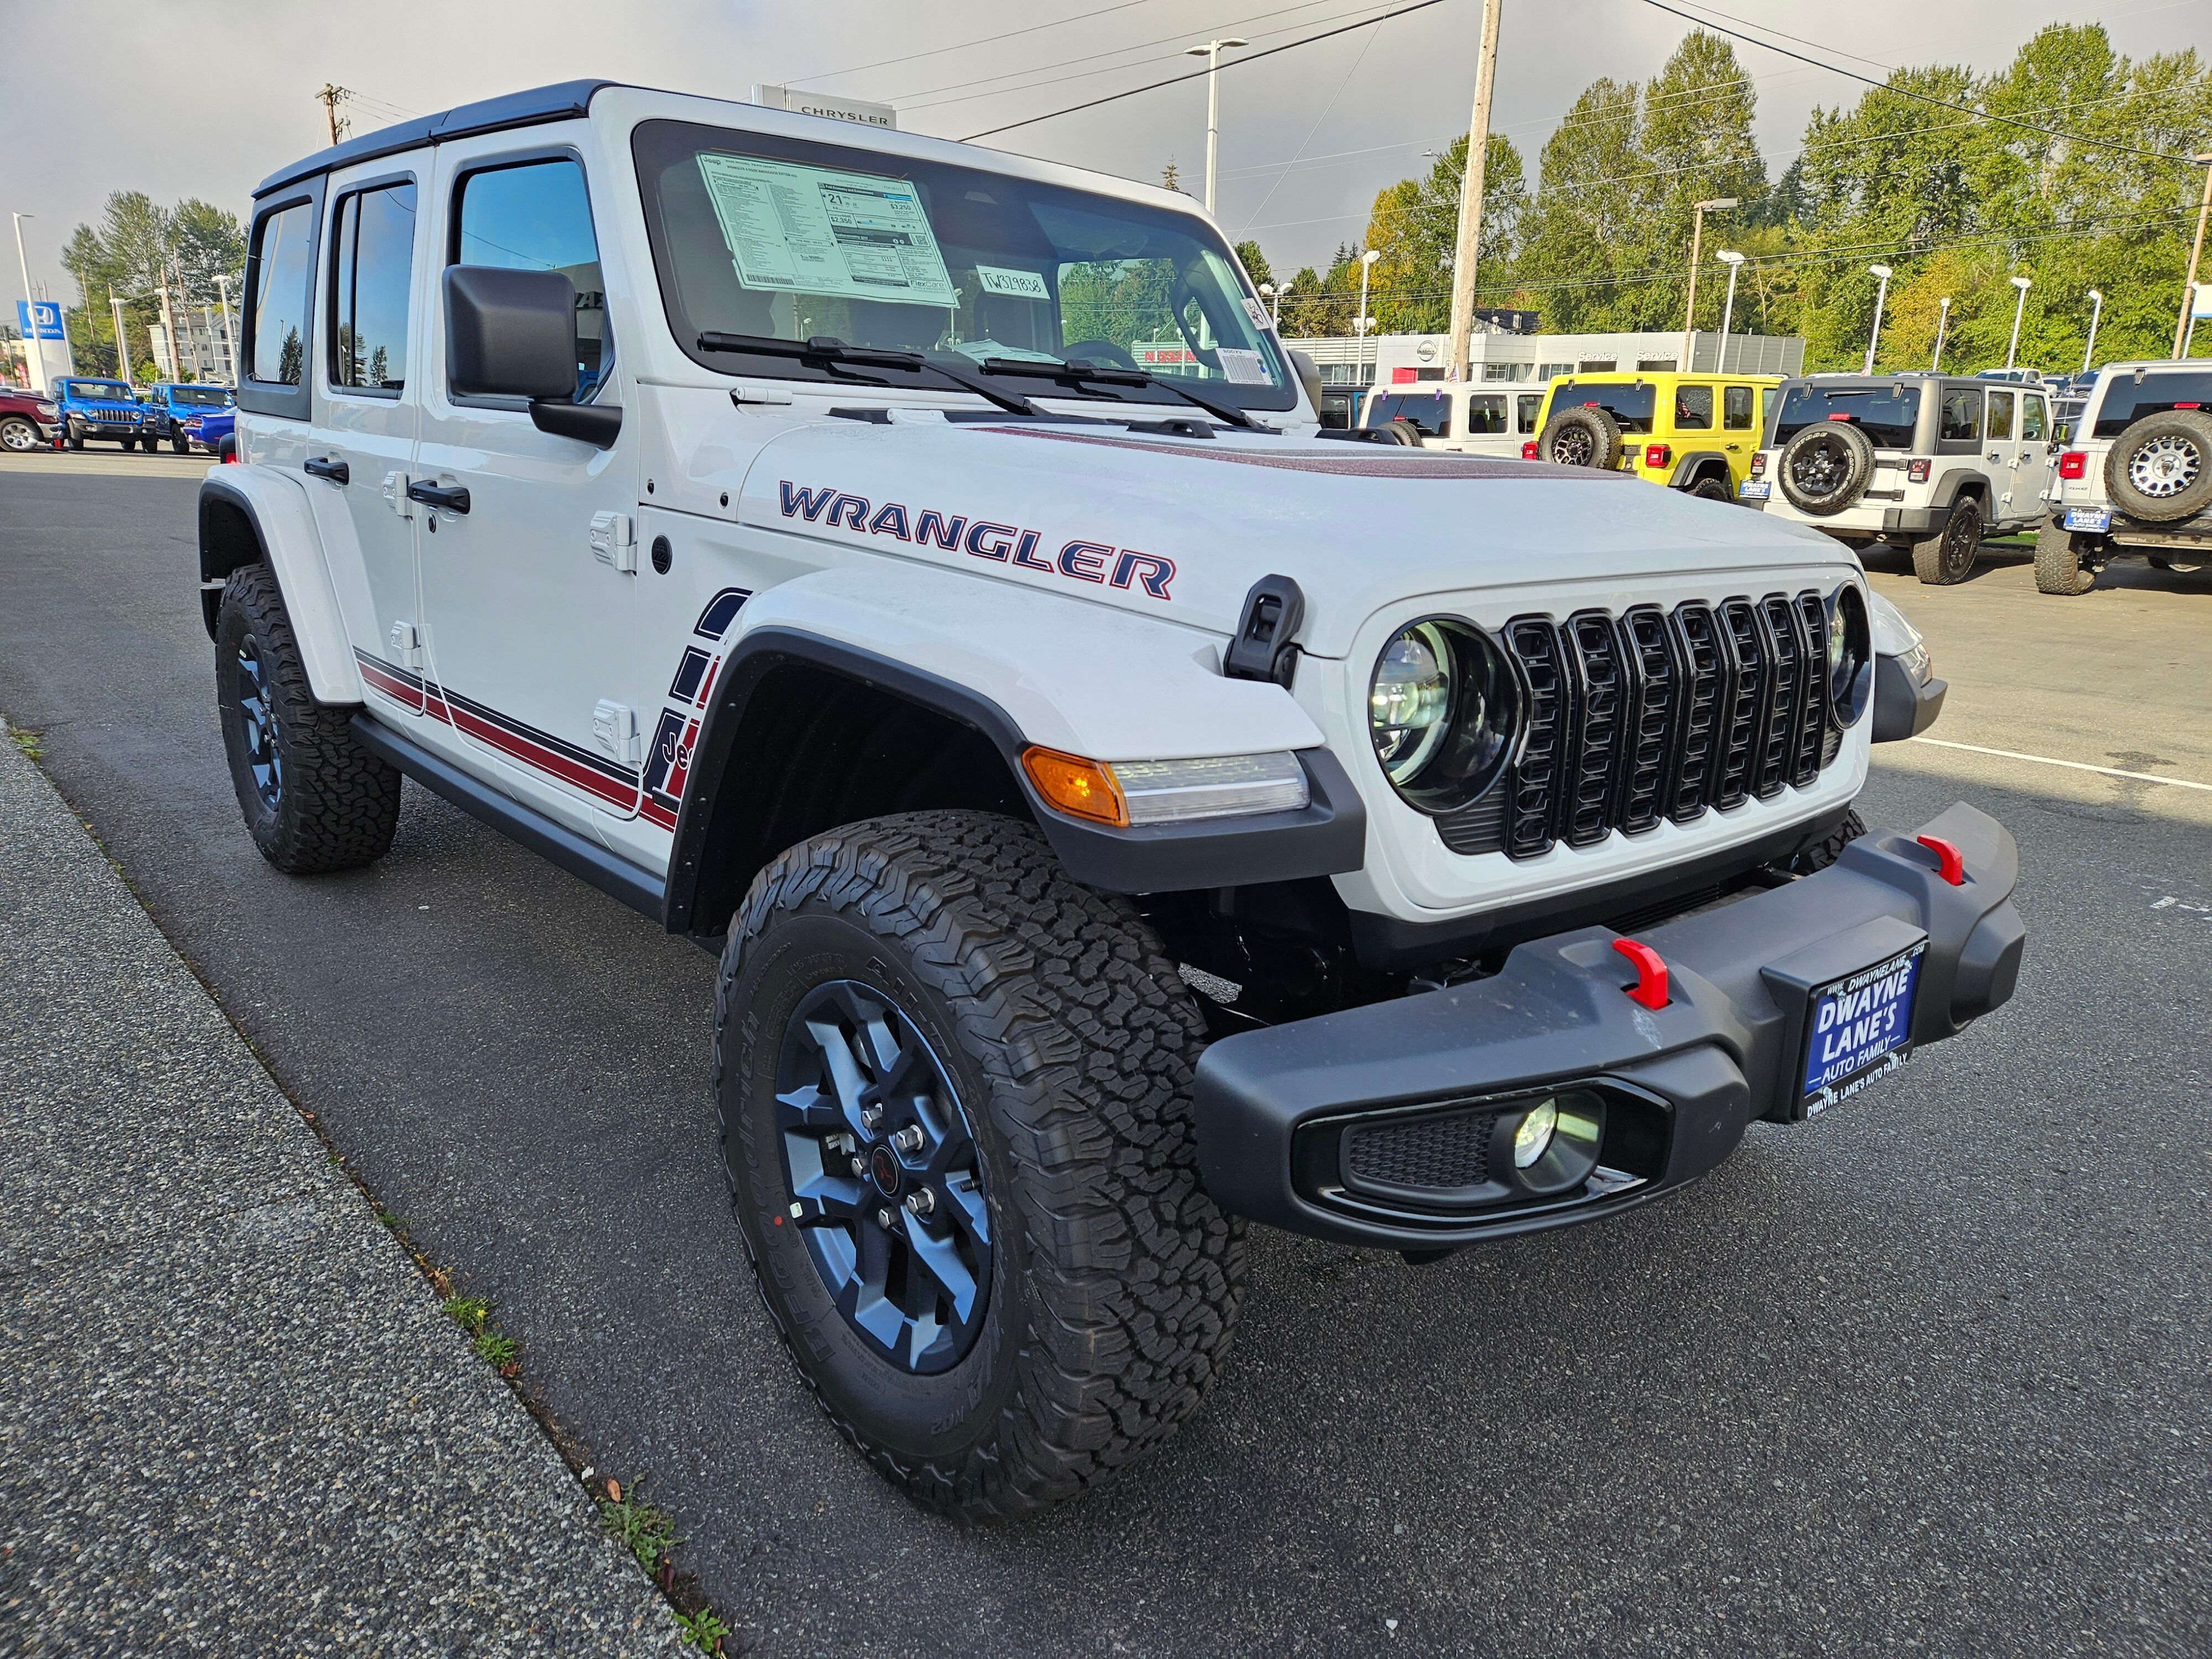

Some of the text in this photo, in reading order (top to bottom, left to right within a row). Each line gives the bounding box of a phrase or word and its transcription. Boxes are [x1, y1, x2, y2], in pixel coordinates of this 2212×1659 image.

[802, 107, 888, 126] CHRYSLER
[828, 194, 842, 204] 21
[982, 273, 1041, 293] TW329838
[1145, 350, 1196, 362] NSSAN
[1578, 351, 1618, 361] Service
[1636, 350, 1679, 361] Service
[780, 479, 1176, 601] WRANGLER
[662, 732, 693, 770] Je
[1848, 954, 1907, 992] DWAYNELANE
[1818, 968, 1910, 1034] DWAYNE
[1822, 1001, 1897, 1063] LANE'S
[1821, 1037, 1891, 1085] AUTO FAMILY
[1807, 1052, 1907, 1118] DWAYNE LANE'S AUTO FAMILY
